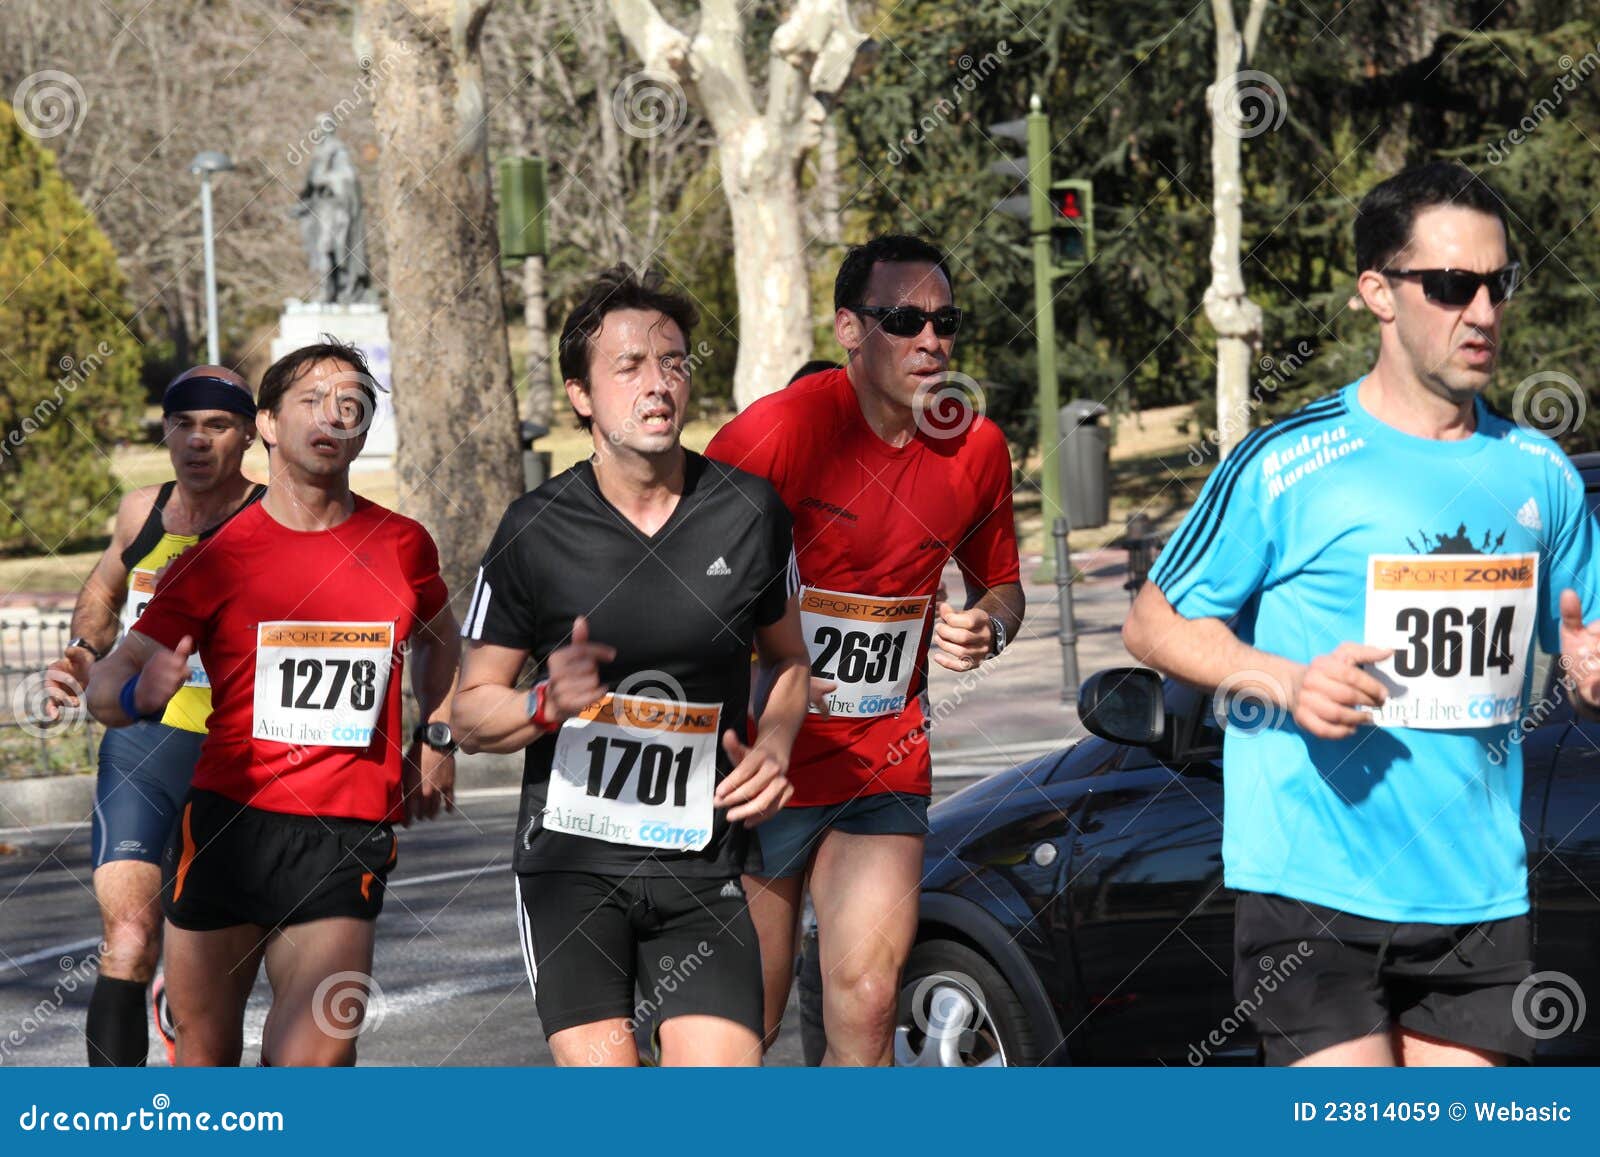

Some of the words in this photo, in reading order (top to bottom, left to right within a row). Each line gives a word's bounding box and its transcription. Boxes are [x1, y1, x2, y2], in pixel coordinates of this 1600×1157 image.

[1267, 437, 1367, 503] Marathon
[810, 626, 908, 684] 2631
[1394, 605, 1516, 678] 3614
[279, 658, 377, 711] 1278
[586, 735, 694, 807] 1701
[549, 807, 632, 841] AireLibre
